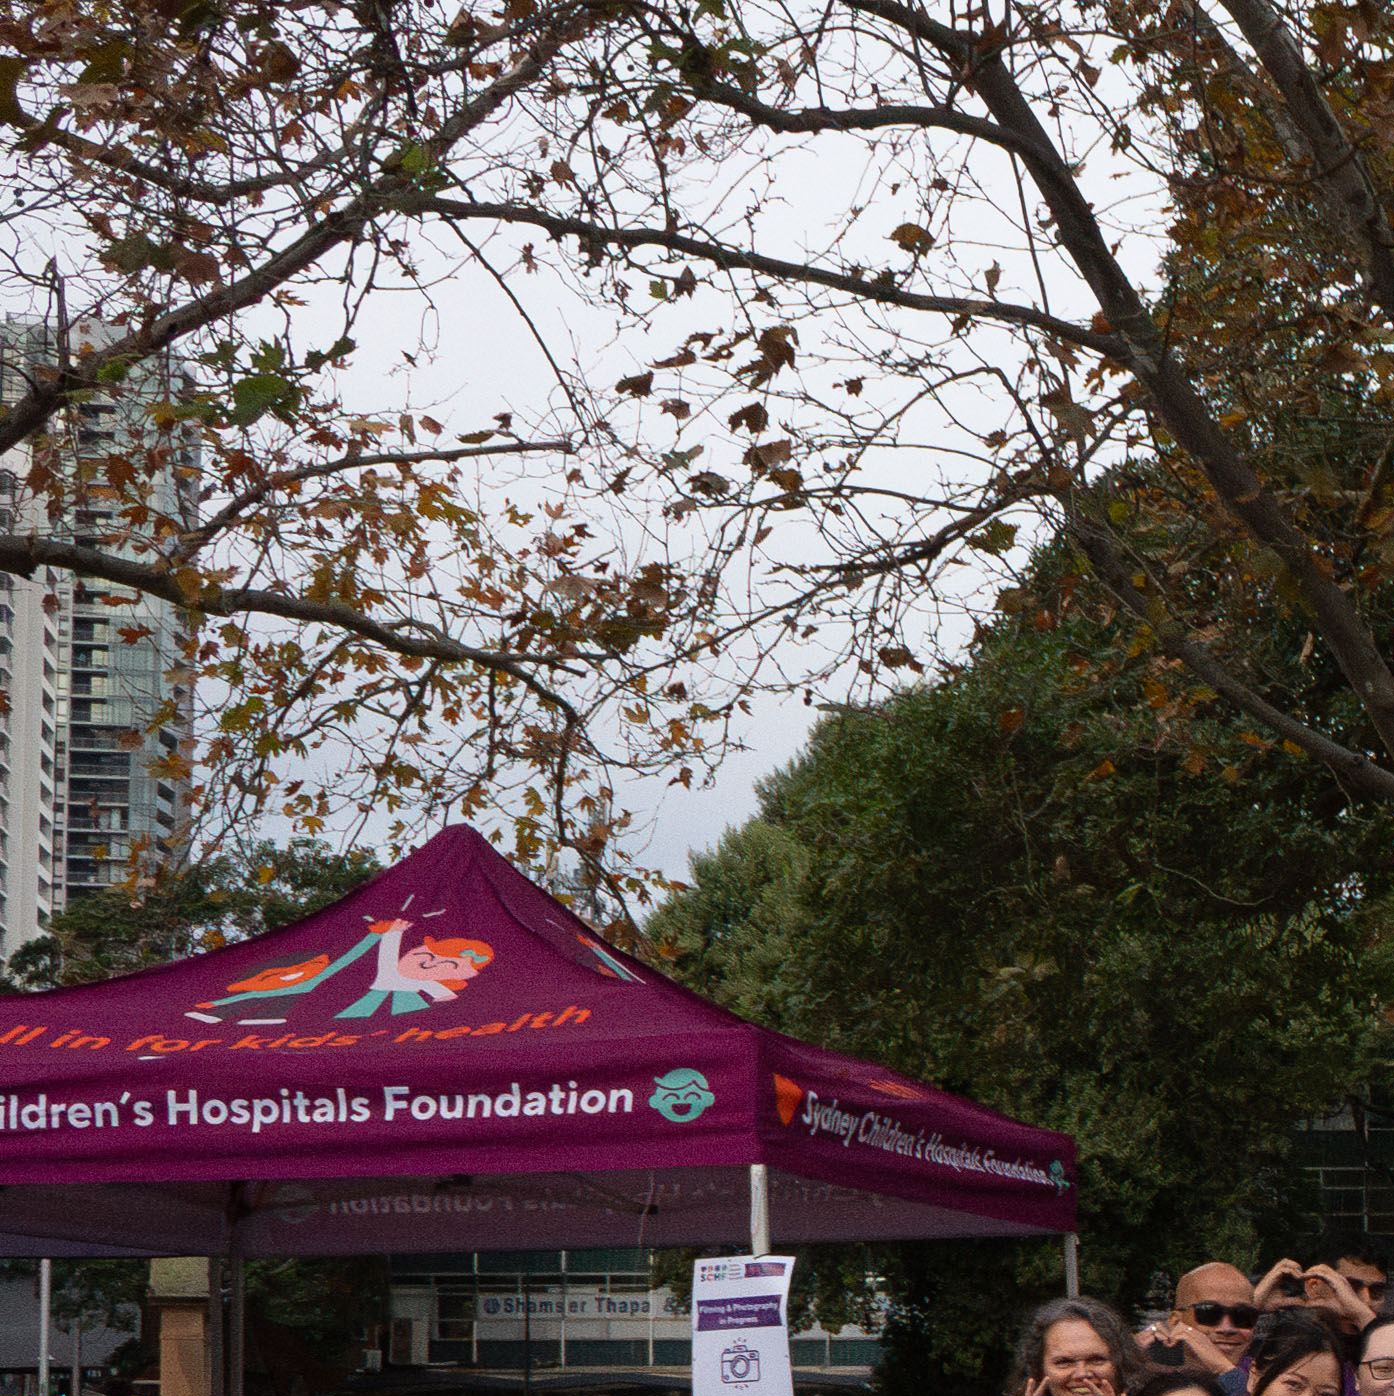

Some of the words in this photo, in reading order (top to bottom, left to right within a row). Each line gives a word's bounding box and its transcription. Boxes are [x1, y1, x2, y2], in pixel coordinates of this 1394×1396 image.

[50, 1030, 113, 1049] in
[126, 1035, 224, 1053] for
[394, 1005, 593, 1043] health
[167, 1087, 370, 1133] Hospitals
[383, 1080, 633, 1121] Foundation
[801, 1090, 858, 1147] Sydney
[858, 1112, 924, 1159] Children's
[925, 1132, 986, 1173] Hospitals
[594, 1297, 650, 1316] Thapa
